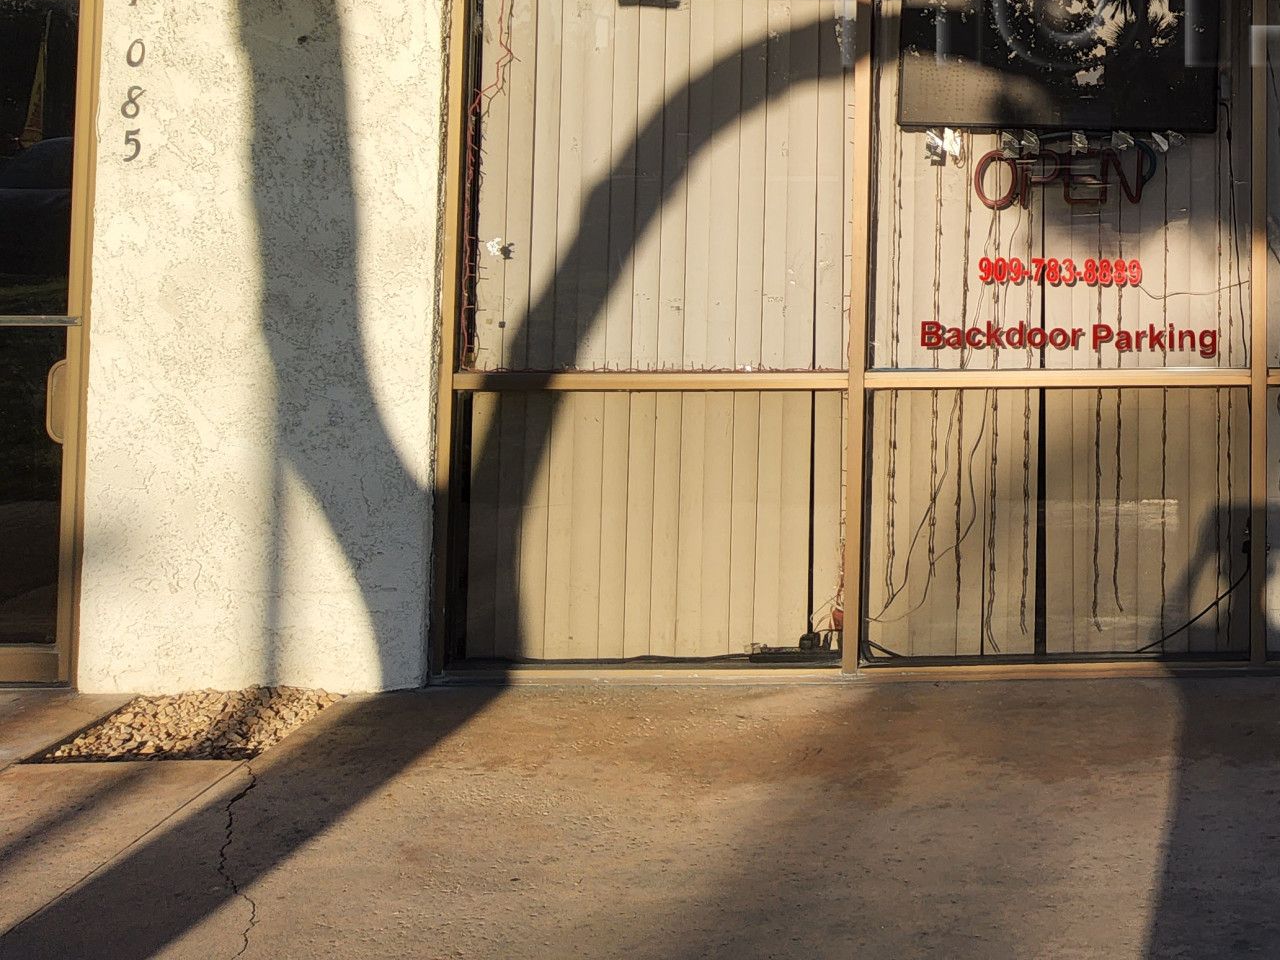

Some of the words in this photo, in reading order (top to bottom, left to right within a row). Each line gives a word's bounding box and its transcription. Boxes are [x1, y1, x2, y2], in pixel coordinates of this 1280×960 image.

[974, 147, 1145, 209] OPEN
[978, 256, 1144, 287] 909-783-8889
[920, 320, 1084, 349] Backdoor
[1092, 322, 1218, 358] Parking
